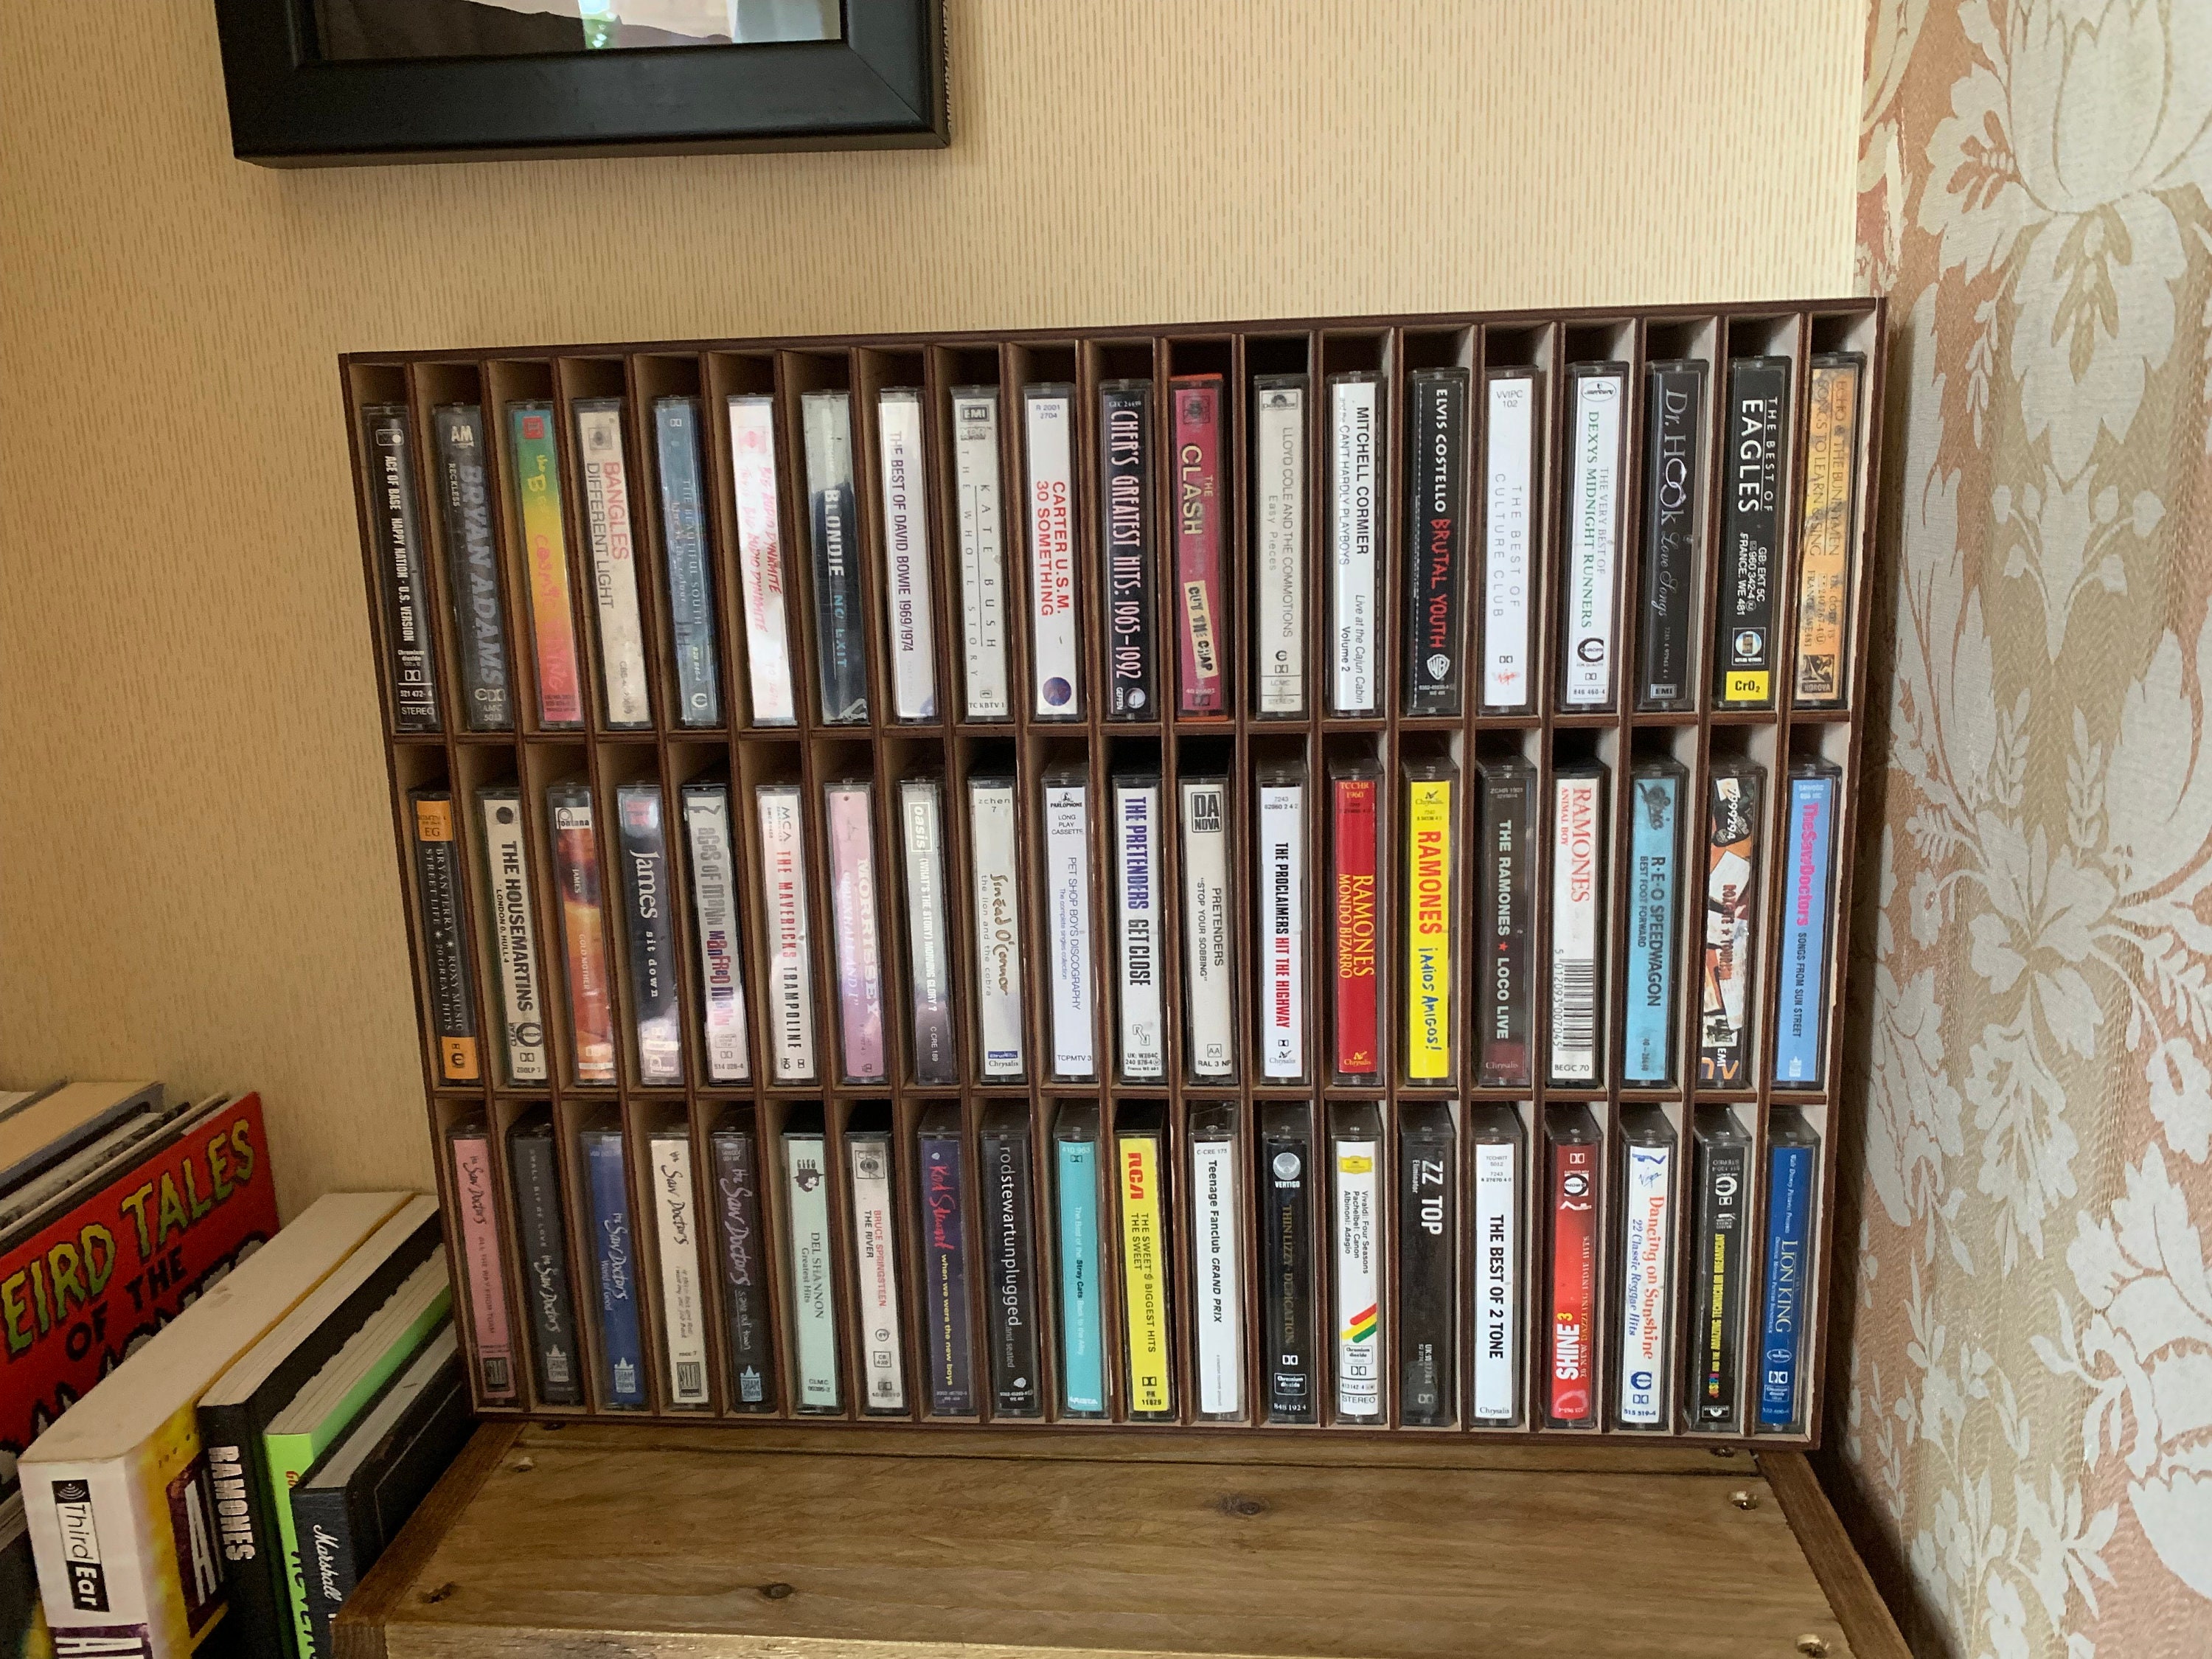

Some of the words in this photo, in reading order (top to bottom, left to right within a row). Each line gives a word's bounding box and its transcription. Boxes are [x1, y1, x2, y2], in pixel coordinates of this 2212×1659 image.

[1436, 389, 1447, 429] ELVIS
[1767, 397, 1778, 431] THE
[890, 431, 902, 454] THE
[1110, 410, 1138, 466] CHER'S
[1282, 427, 1294, 466] LLOYD
[1356, 407, 1369, 481] MITCHELL
[1587, 411, 1599, 464] DEXYS
[385, 456, 398, 471] ACE
[1435, 434, 1447, 512] COSTELLO
[1738, 399, 1763, 512] EAGLES
[1765, 441, 1776, 481] BEST
[387, 476, 399, 485] OF
[448, 463, 459, 507] RECKLESS
[891, 459, 905, 490] BEST
[1036, 481, 1049, 501] 30
[1180, 445, 1203, 535] CLASH
[1203, 475, 1213, 497] THE
[1282, 469, 1294, 501] COLE
[389, 488, 400, 509] BASE
[586, 462, 608, 557] DIFFERENT
[604, 462, 628, 560] BANGLES
[894, 495, 905, 510] OF
[1111, 476, 1140, 546] GREATEST
[1283, 503, 1293, 529] AND
[1583, 468, 1597, 549] MIDNIGHT
[1764, 491, 1774, 512] OF
[391, 518, 404, 544] HAPPY
[824, 490, 844, 576] BLONDIE
[894, 515, 908, 551] DAVID
[1053, 481, 1067, 553] CARTER
[1356, 486, 1369, 554] CORMIER
[1494, 474, 1506, 560] CULTURE
[1283, 532, 1293, 554] THE
[1430, 519, 1451, 589] BRUTAL
[394, 548, 408, 578] NATION
[896, 556, 910, 594] BOWIE
[1037, 508, 1053, 616] SOMETHING
[1113, 557, 1141, 595] HITS:
[398, 587, 411, 603] U.S.
[595, 560, 613, 608] LIGHT
[1055, 559, 1068, 614] U.S.M.
[1282, 557, 1293, 637] COMMOTIONS
[1493, 570, 1505, 617] CLUB
[1581, 554, 1594, 627] RUNNERS
[1355, 595, 1365, 613] Live
[1355, 616, 1364, 625] at
[1429, 594, 1447, 648] YOUTH
[399, 606, 414, 641] VERSION
[899, 599, 913, 651] 1969/1974
[1354, 628, 1365, 642] the
[1340, 627, 1352, 662] Volume
[1352, 645, 1366, 675] Cajun
[1116, 687, 1124, 710] GEFFEN
[1354, 677, 1365, 703] Cabin
[1125, 797, 1147, 821] THE
[1560, 787, 1568, 824] ANIMAL
[1726, 788, 1739, 840] 7999294
[1276, 843, 1289, 860] THE
[1498, 820, 1512, 853] THE
[1559, 827, 1568, 846] BOY
[1571, 787, 1593, 902] RAMONES
[502, 841, 518, 874] THE
[777, 850, 791, 872] THE
[1068, 857, 1077, 876] PET
[1126, 825, 1149, 909] PRETENDERS
[1639, 856, 1648, 877] BEST
[629, 850, 661, 918] James
[1068, 879, 1078, 907] SHOP
[1276, 864, 1290, 934] PROCLAIMERS
[1338, 874, 1352, 924] MONDO
[1419, 831, 1442, 934] RAMONES
[1498, 857, 1510, 936] RAMONES
[1638, 879, 1648, 903] FOOT
[495, 889, 506, 924] LONDON
[779, 882, 797, 958] MAVERICKS
[1069, 909, 1079, 936] BOYS
[645, 931, 655, 951] sit
[1128, 919, 1150, 944] GET
[1212, 888, 1223, 967] PRETENDERS
[1352, 874, 1374, 976] RAMONES
[1638, 905, 1646, 947] FORWARD
[500, 935, 508, 955] HULL
[505, 879, 532, 1011] HOUSEMARTINS
[1276, 937, 1290, 957] HIT
[1339, 928, 1352, 978] BIZARRO
[1647, 905, 1664, 1006] SPEEDWAGON
[1797, 933, 1807, 960] SONGS
[647, 959, 658, 997] down
[1071, 939, 1080, 1010] DISCOGRAPHY
[1130, 945, 1151, 986] CLOSE
[1276, 959, 1290, 976] THE
[1497, 958, 1509, 1000] LOCO
[1554, 963, 1564, 1003] 012093
[1795, 963, 1805, 987] FROM
[783, 967, 801, 1048] TRAMPOLINE
[1276, 980, 1290, 1028] HIGHWAY
[1794, 989, 1804, 1005] SUN
[1496, 1006, 1509, 1039] LIVE
[1553, 1007, 1563, 1046] 007045
[1792, 1008, 1803, 1037] STREET
[1717, 1048, 1727, 1067] EMI
[122, 1118, 254, 1258] TALES
[1128, 1152, 1144, 1200] RCA
[1208, 1161, 1219, 1206] Teenage
[1411, 1160, 1419, 1193] Eliminator
[1422, 1161, 1443, 1185] ZZ
[864, 1211, 873, 1229] THE
[1343, 1191, 1352, 1225] Albinoni:
[1352, 1191, 1360, 1231] Pachelbel:
[1361, 1191, 1369, 1219] Vivaldi:
[1421, 1195, 1443, 1235] TOP
[874, 1210, 883, 1240] BRUCE
[1131, 1214, 1140, 1233] THE
[1141, 1213, 1150, 1233] THE
[1210, 1211, 1220, 1253] Fanclub
[1343, 1227, 1352, 1253] Adagio
[1362, 1221, 1370, 1239] Four
[1489, 1214, 1504, 1242] THE
[1632, 1219, 1643, 1232] 22
[1642, 1196, 1665, 1261] Dancing
[811, 1232, 821, 1254] DEL
[866, 1232, 874, 1258] RIVER
[1133, 1236, 1142, 1270] SWEET
[1353, 1234, 1361, 1259] Canon
[1362, 1241, 1370, 1274] Seasons
[1630, 1234, 1642, 1270] Classic
[1780, 1240, 1798, 1281] LION
[801, 1248, 810, 1283] Greatest
[875, 1244, 886, 1307] SPRINGSTEEN
[1075, 1259, 1083, 1279] Stray
[1211, 1257, 1221, 1295] GRAND
[1489, 1247, 1504, 1281] BEST
[1645, 1266, 1658, 1284] on
[66, 1301, 108, 1360] OF
[125, 1248, 186, 1311] THE
[804, 1285, 812, 1303] Hits
[813, 1258, 824, 1318] SHANNON
[1144, 1284, 1155, 1327] BIGGEST
[1489, 1287, 1504, 1304] OF
[1627, 1273, 1641, 1310] Reggae
[1213, 1298, 1222, 1323] PRIX
[1489, 1310, 1503, 1318] 2
[1557, 1312, 1573, 1321] 3
[1629, 1313, 1640, 1335] Hits
[1643, 1289, 1657, 1360] Sunshine
[1775, 1287, 1793, 1332] KING
[1147, 1331, 1155, 1352] HITS
[1489, 1324, 1503, 1358] TONE
[1555, 1324, 1579, 1380] SHINE
[209, 1445, 256, 1561] RAMONES
[313, 1524, 343, 1602] Marshall
